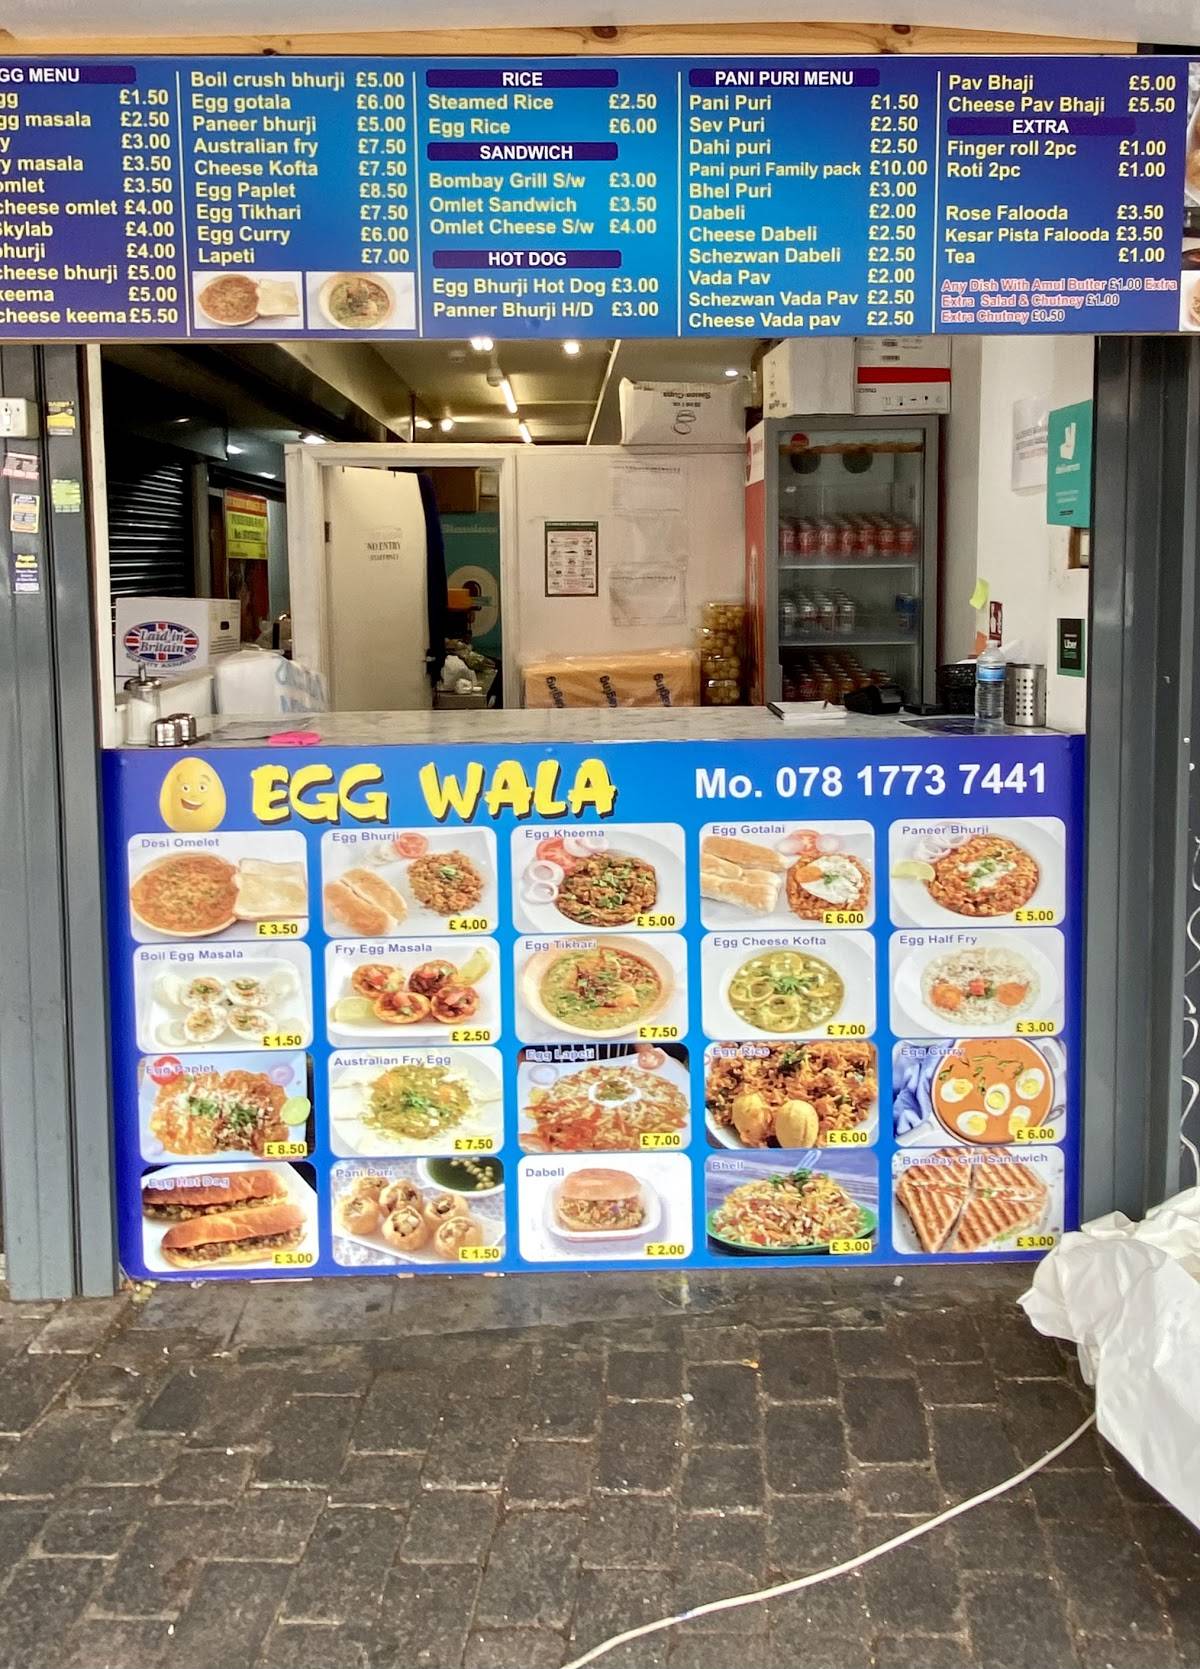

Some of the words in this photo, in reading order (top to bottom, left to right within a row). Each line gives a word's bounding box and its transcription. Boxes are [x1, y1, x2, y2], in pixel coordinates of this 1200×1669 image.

[29, 68, 81, 82] MENU
[191, 71, 228, 87] Boil
[233, 72, 286, 87] crush
[291, 71, 346, 92] bhurji
[502, 71, 545, 87] RICE
[715, 71, 755, 85] PANI
[759, 71, 800, 85] PURI
[804, 71, 854, 85] MENU
[948, 74, 984, 90] Pav
[989, 74, 1035, 94] Bhaji
[1129, 75, 1177, 91] £5.00
[119, 88, 170, 105] £1.50
[192, 93, 229, 113] Egg
[234, 94, 292, 113] gotala
[428, 93, 509, 110] Steamed
[513, 94, 555, 110] Rice
[608, 93, 658, 110] £2.50
[689, 94, 730, 110] Pani
[735, 95, 773, 110] Puri
[948, 96, 1016, 112] Cheese
[1021, 96, 1055, 112] Pav
[1059, 96, 1106, 116] Bhaji
[25, 111, 92, 127] masala
[120, 111, 170, 127] £2.50
[193, 115, 258, 131] Paneer
[263, 115, 317, 135] bhurji
[689, 116, 724, 133] Sev
[729, 117, 766, 132] Puri
[1013, 119, 1070, 134] EXTRA
[429, 118, 466, 138] Egg
[471, 118, 512, 134] Rice
[609, 118, 658, 134] £6.00
[193, 138, 289, 153] Australian
[293, 138, 320, 158] fry
[479, 145, 574, 160] SANDWICH
[689, 138, 731, 155] Dahi
[736, 138, 772, 158] puri
[947, 140, 1006, 159] Finger
[1010, 140, 1040, 156] roll
[1044, 140, 1078, 159] 2pc
[17, 155, 85, 171] masala
[122, 155, 172, 171] £3.50
[194, 159, 264, 176] Cheese
[269, 160, 320, 176] Kofta
[689, 162, 725, 176] Pani
[729, 162, 762, 180] puri
[765, 161, 820, 180] Family
[822, 161, 862, 179] pack
[947, 162, 984, 178] Roti
[988, 162, 1022, 181] 2pc
[428, 172, 505, 192] Bombay
[509, 172, 548, 188] Grill
[553, 172, 587, 188] S/w
[609, 171, 658, 188] £3.00
[195, 181, 233, 201] Egg
[238, 182, 297, 201] Paplet
[689, 183, 730, 198] Bhel
[736, 183, 773, 198] Puri
[65, 199, 119, 215] omlet
[429, 196, 484, 212] Omlet
[489, 196, 578, 212] Sandwich
[609, 196, 658, 212] £3.50
[689, 204, 746, 220] Dabeli
[196, 203, 233, 223] Egg
[238, 204, 302, 220] Tikhari
[946, 205, 993, 221] Rose
[997, 205, 1069, 220] Falooda
[429, 218, 485, 235] Omlet
[489, 219, 558, 235] Cheese
[561, 218, 596, 234] S/w
[609, 218, 658, 234] £4.00
[688, 226, 757, 242] Cheese
[761, 225, 819, 241] Dabeli
[945, 228, 995, 242] Kesar
[998, 228, 1040, 242] Pista
[1044, 227, 1110, 242] Falooda
[197, 225, 234, 245] Egg
[239, 226, 292, 246] Curry
[198, 248, 256, 266] Lapeti
[487, 251, 527, 266] HOT
[528, 251, 568, 266] DOG
[689, 248, 780, 264] Schezwan
[785, 247, 843, 263] Dabeli
[944, 248, 976, 264] Tea
[64, 264, 119, 284] bhurji
[688, 270, 733, 285] Vada
[738, 269, 772, 285] Pav
[432, 278, 469, 297] Egg
[474, 278, 529, 297] Bhurji
[533, 278, 566, 293] Hot
[570, 278, 607, 297] Dog
[611, 277, 660, 293] £3.00
[689, 292, 776, 307] Schezwan
[779, 290, 823, 306] Vada
[827, 290, 860, 305] Pav
[66, 307, 128, 323] keema
[433, 302, 499, 317] Panner
[503, 302, 557, 321] Bhurji
[562, 302, 595, 317] H/D
[611, 301, 660, 317] £3.00
[941, 311, 974, 323] Extra
[976, 310, 1028, 324] Chutney
[1031, 309, 1065, 322] £0.50
[688, 313, 756, 328] Cheese
[760, 312, 805, 327] Vada
[809, 315, 842, 330] pav
[140, 630, 168, 641] Laid
[171, 631, 184, 641] in
[140, 641, 184, 653] Britain
[695, 768, 762, 799] Mo.
[776, 766, 843, 796] 078
[857, 765, 946, 795] 1773
[959, 763, 1047, 794] 7441
[250, 763, 389, 823] EGG
[419, 758, 617, 821] WALA
[332, 832, 357, 844] Egg
[361, 832, 400, 843] Bhurji
[525, 829, 550, 840] Egg
[554, 829, 605, 838] Kheema
[712, 825, 737, 836] Egg
[902, 826, 945, 835] Paneer
[950, 825, 989, 836] Bhurji
[141, 838, 170, 849] Desi
[174, 838, 220, 849] Omelet
[525, 941, 549, 951] Egg
[714, 937, 738, 948] Egg
[742, 937, 789, 946] Cheese
[793, 936, 826, 945] Kofta
[899, 935, 924, 946] Egg
[928, 934, 953, 944] Half
[957, 935, 978, 945] Fry
[140, 951, 165, 961] Boil
[169, 951, 194, 962] Egg
[199, 950, 243, 960] Masala
[335, 945, 355, 955] Fry
[360, 944, 384, 955] Egg
[388, 943, 432, 953] Masala
[334, 1057, 398, 1066] Australian
[402, 1056, 421, 1066] Fry
[427, 1055, 451, 1065] Egg
[903, 1155, 953, 1166] Bombay
[988, 1154, 1048, 1164] Sandwich
